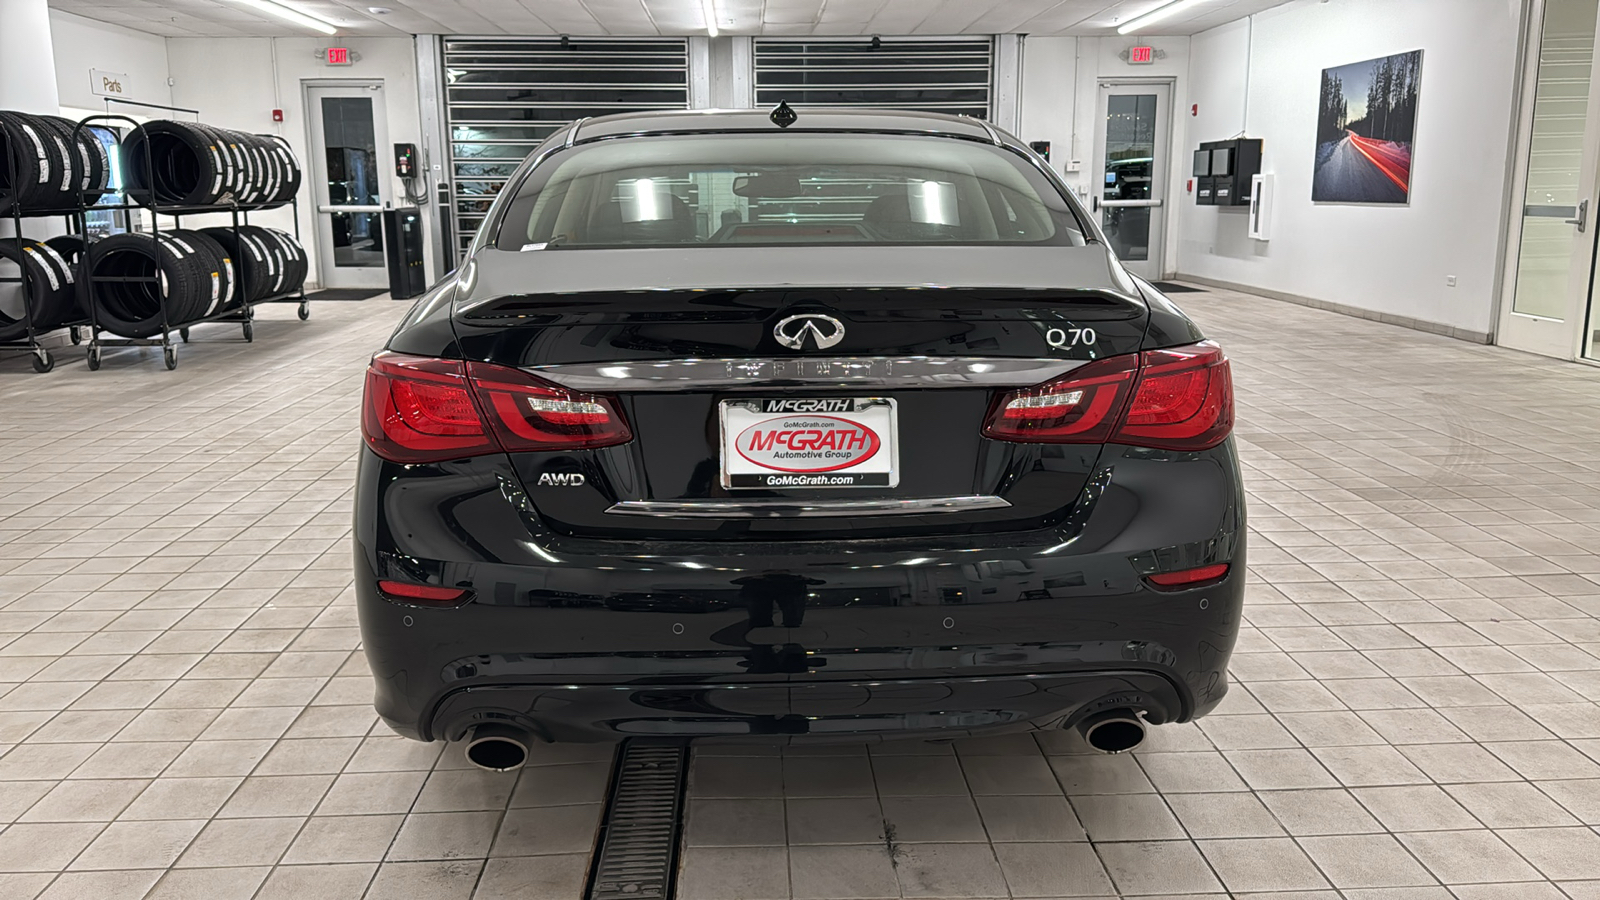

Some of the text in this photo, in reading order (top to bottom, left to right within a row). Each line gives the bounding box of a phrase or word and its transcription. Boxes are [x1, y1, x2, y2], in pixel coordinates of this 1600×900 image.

[327, 47, 347, 64] EXIT
[1132, 46, 1151, 62] EXIT
[103, 76, 122, 93] Parts
[1046, 327, 1096, 351] Q70
[783, 421, 835, 429] GoMcGrath.com
[773, 450, 852, 460] Automotive Group
[537, 472, 585, 487] AWD
[766, 475, 854, 486] GoMcGrath.com
